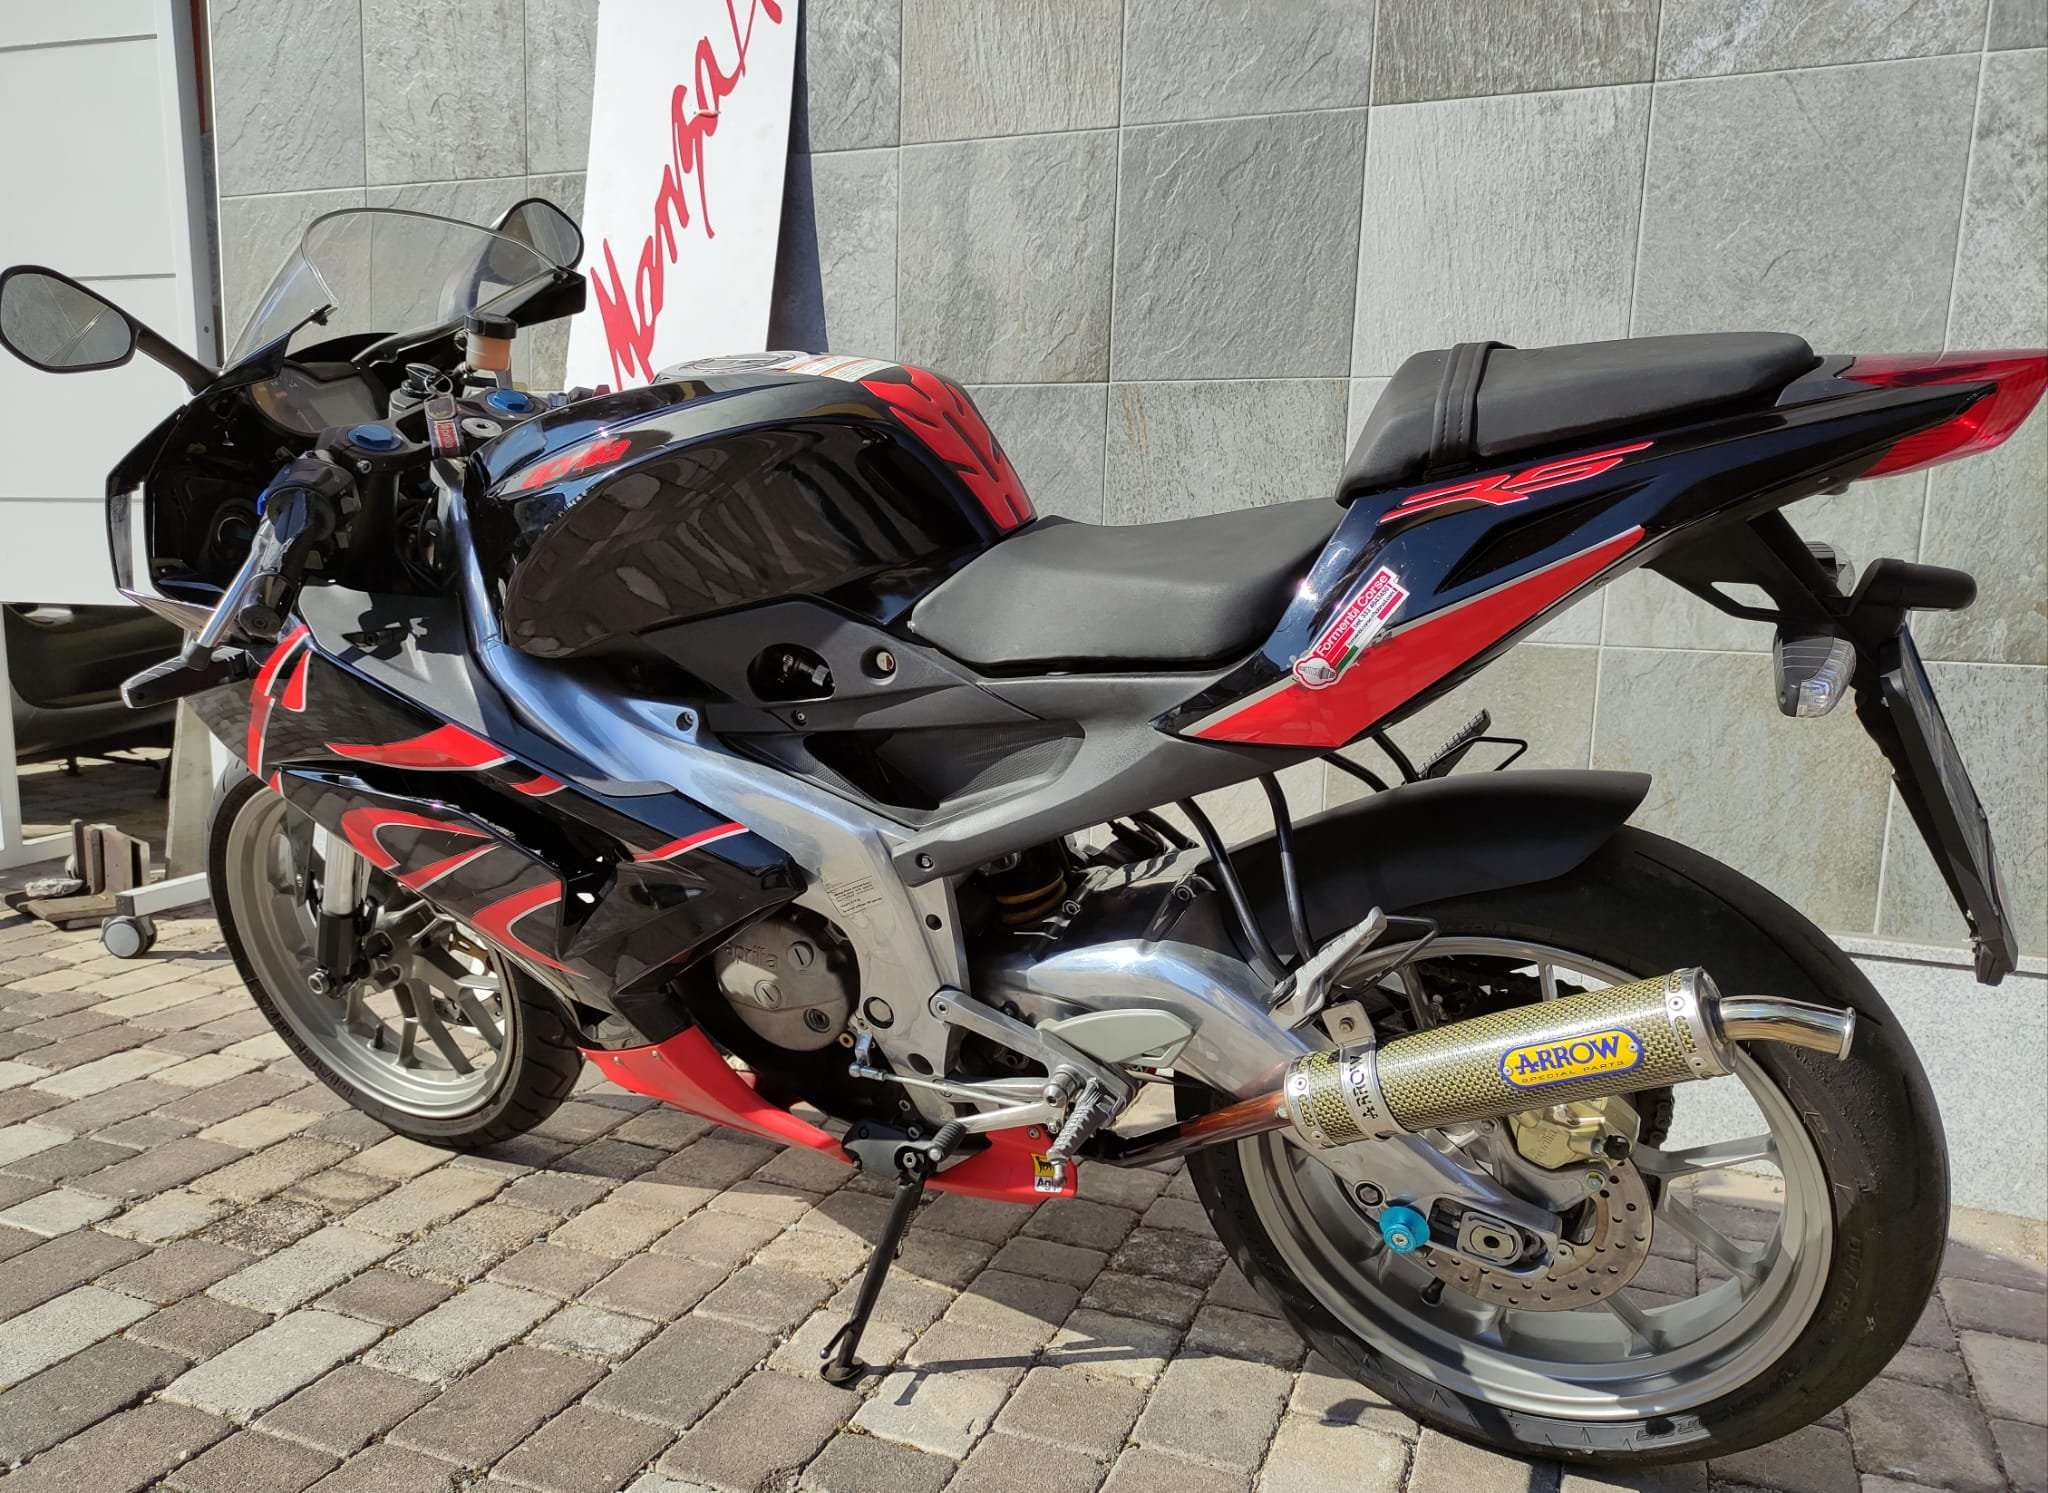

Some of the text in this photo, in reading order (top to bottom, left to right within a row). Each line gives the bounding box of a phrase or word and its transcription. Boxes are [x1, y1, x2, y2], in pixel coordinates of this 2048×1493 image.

[1317, 574, 1388, 656] Formenti Corse
[1515, 1035, 1620, 1075] ARROW
[1521, 1060, 1625, 1084] SPECIAL PARTS
